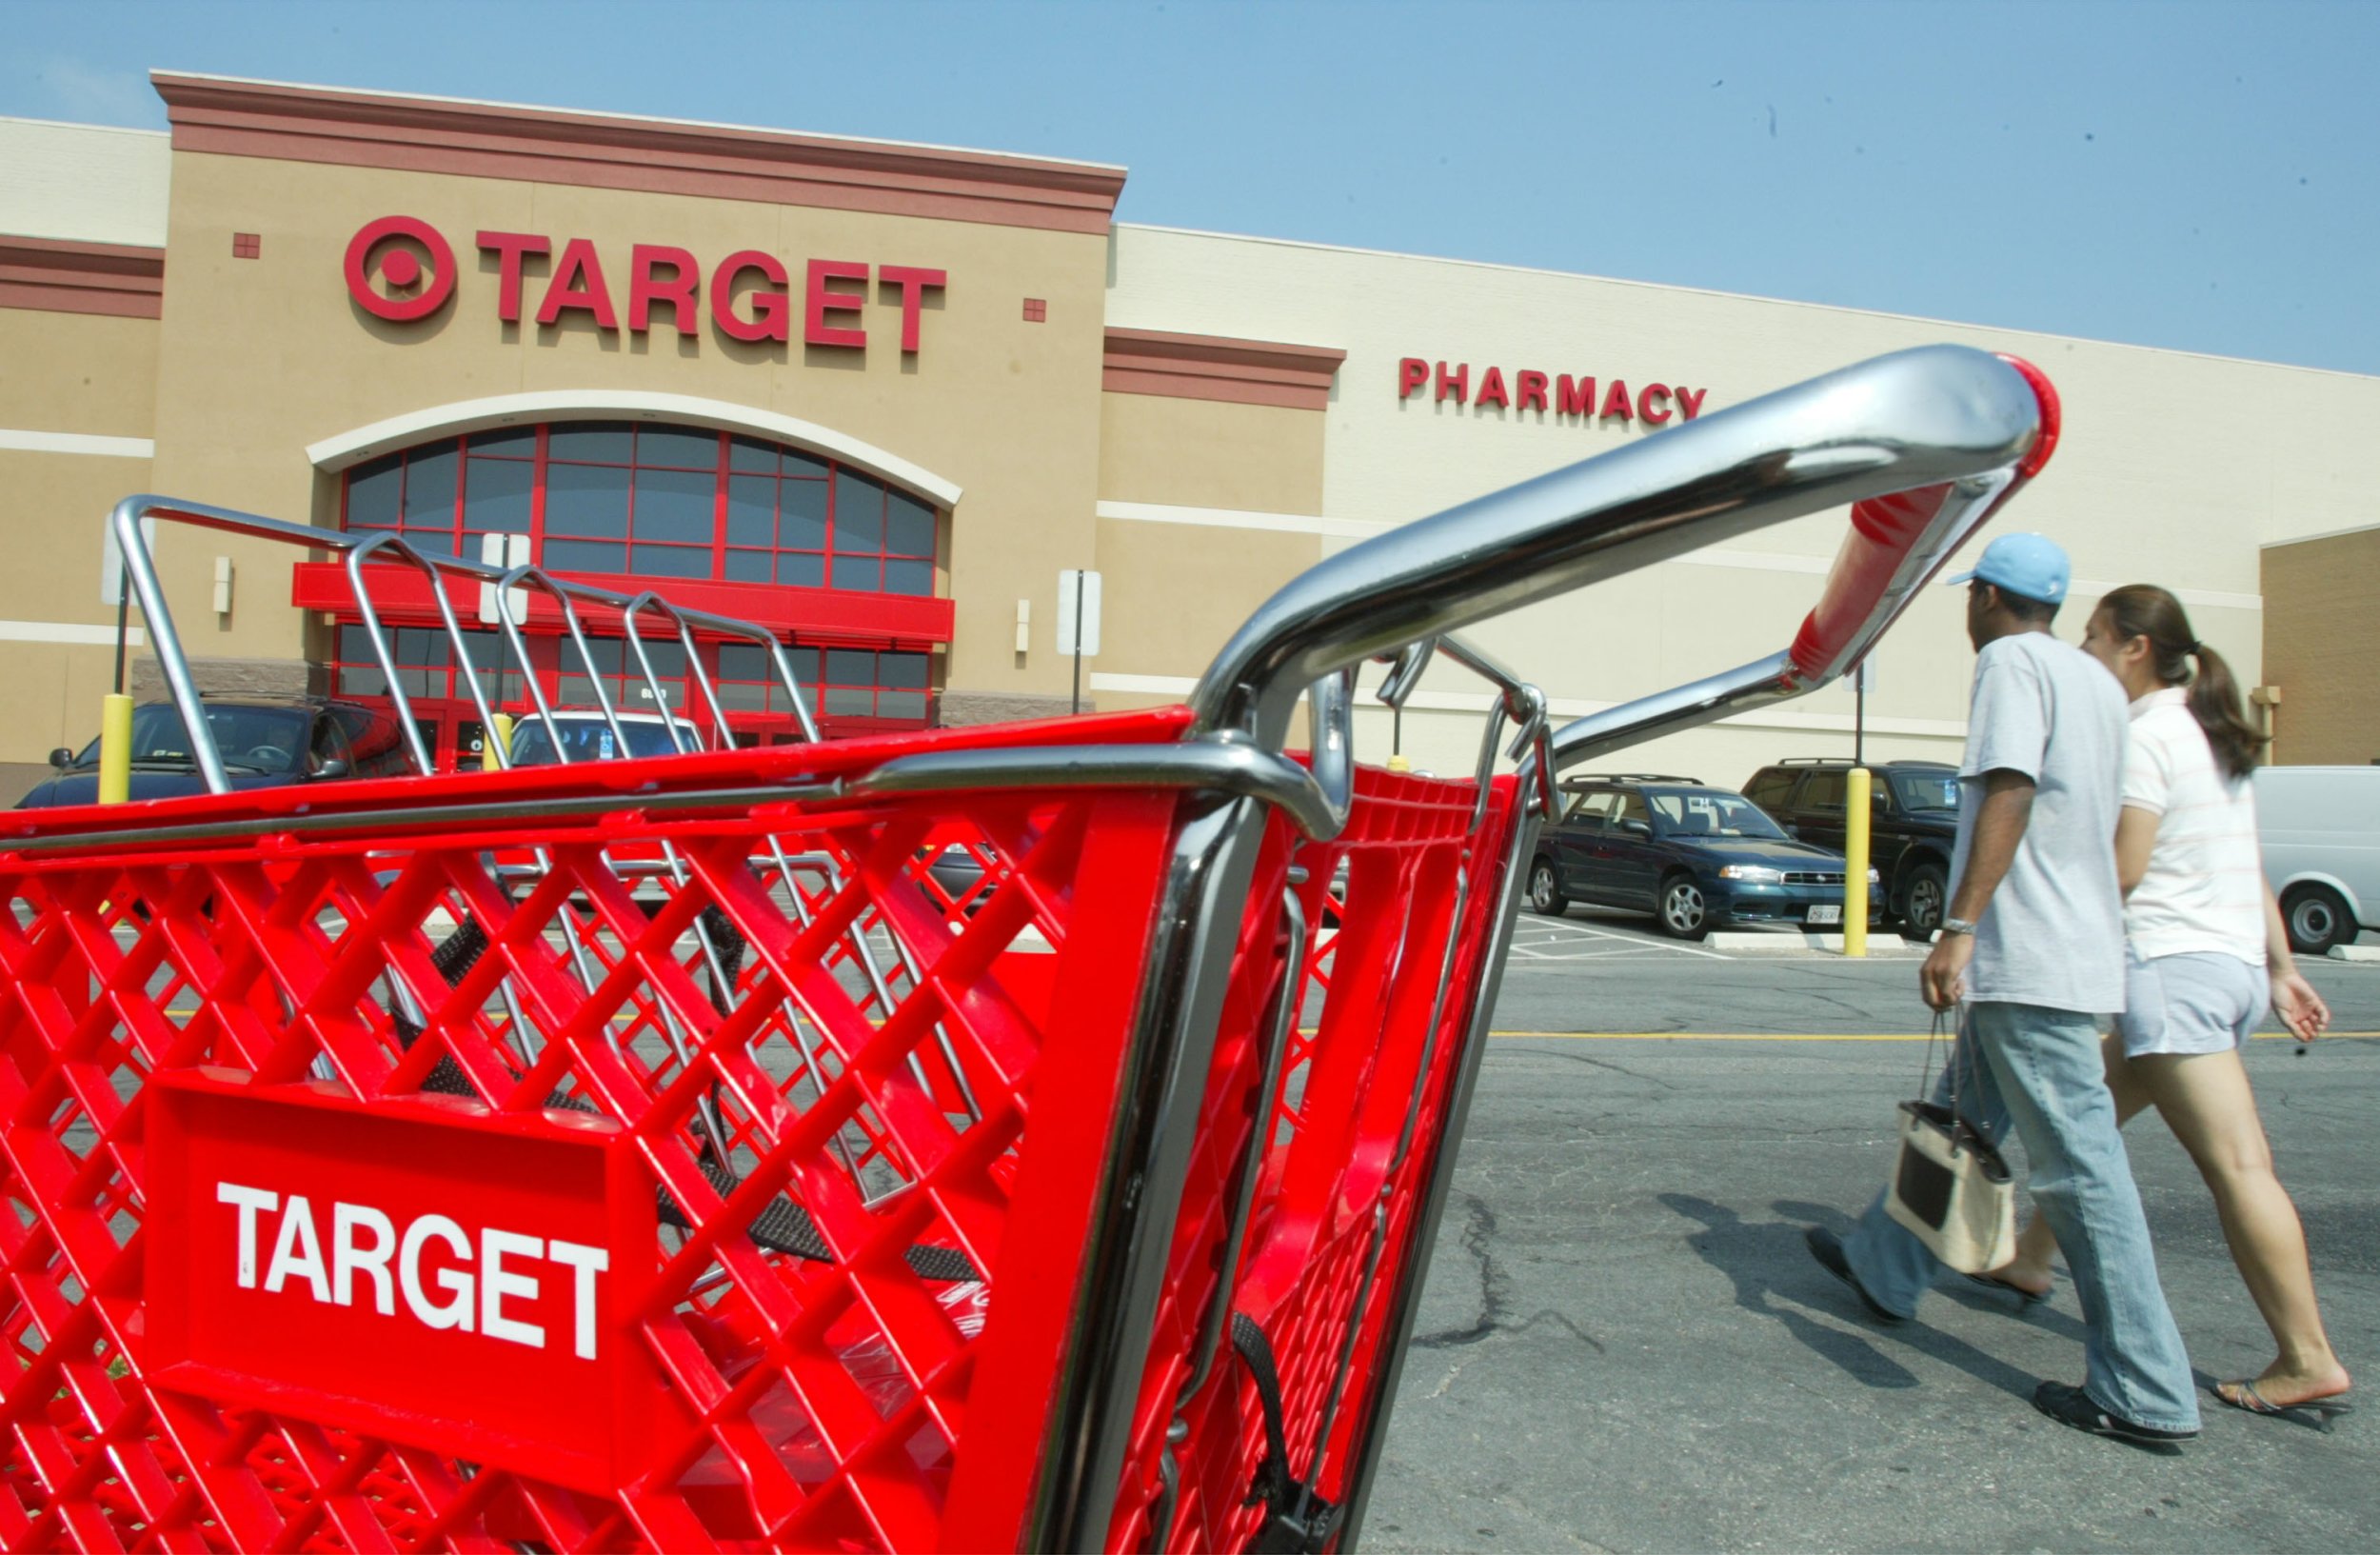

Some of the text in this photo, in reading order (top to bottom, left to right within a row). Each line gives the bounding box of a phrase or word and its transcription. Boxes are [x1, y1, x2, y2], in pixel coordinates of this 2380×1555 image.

[475, 229, 948, 353] TARGET
[1398, 357, 1707, 425] PHARMACY
[216, 1181, 609, 1362] TARGET
